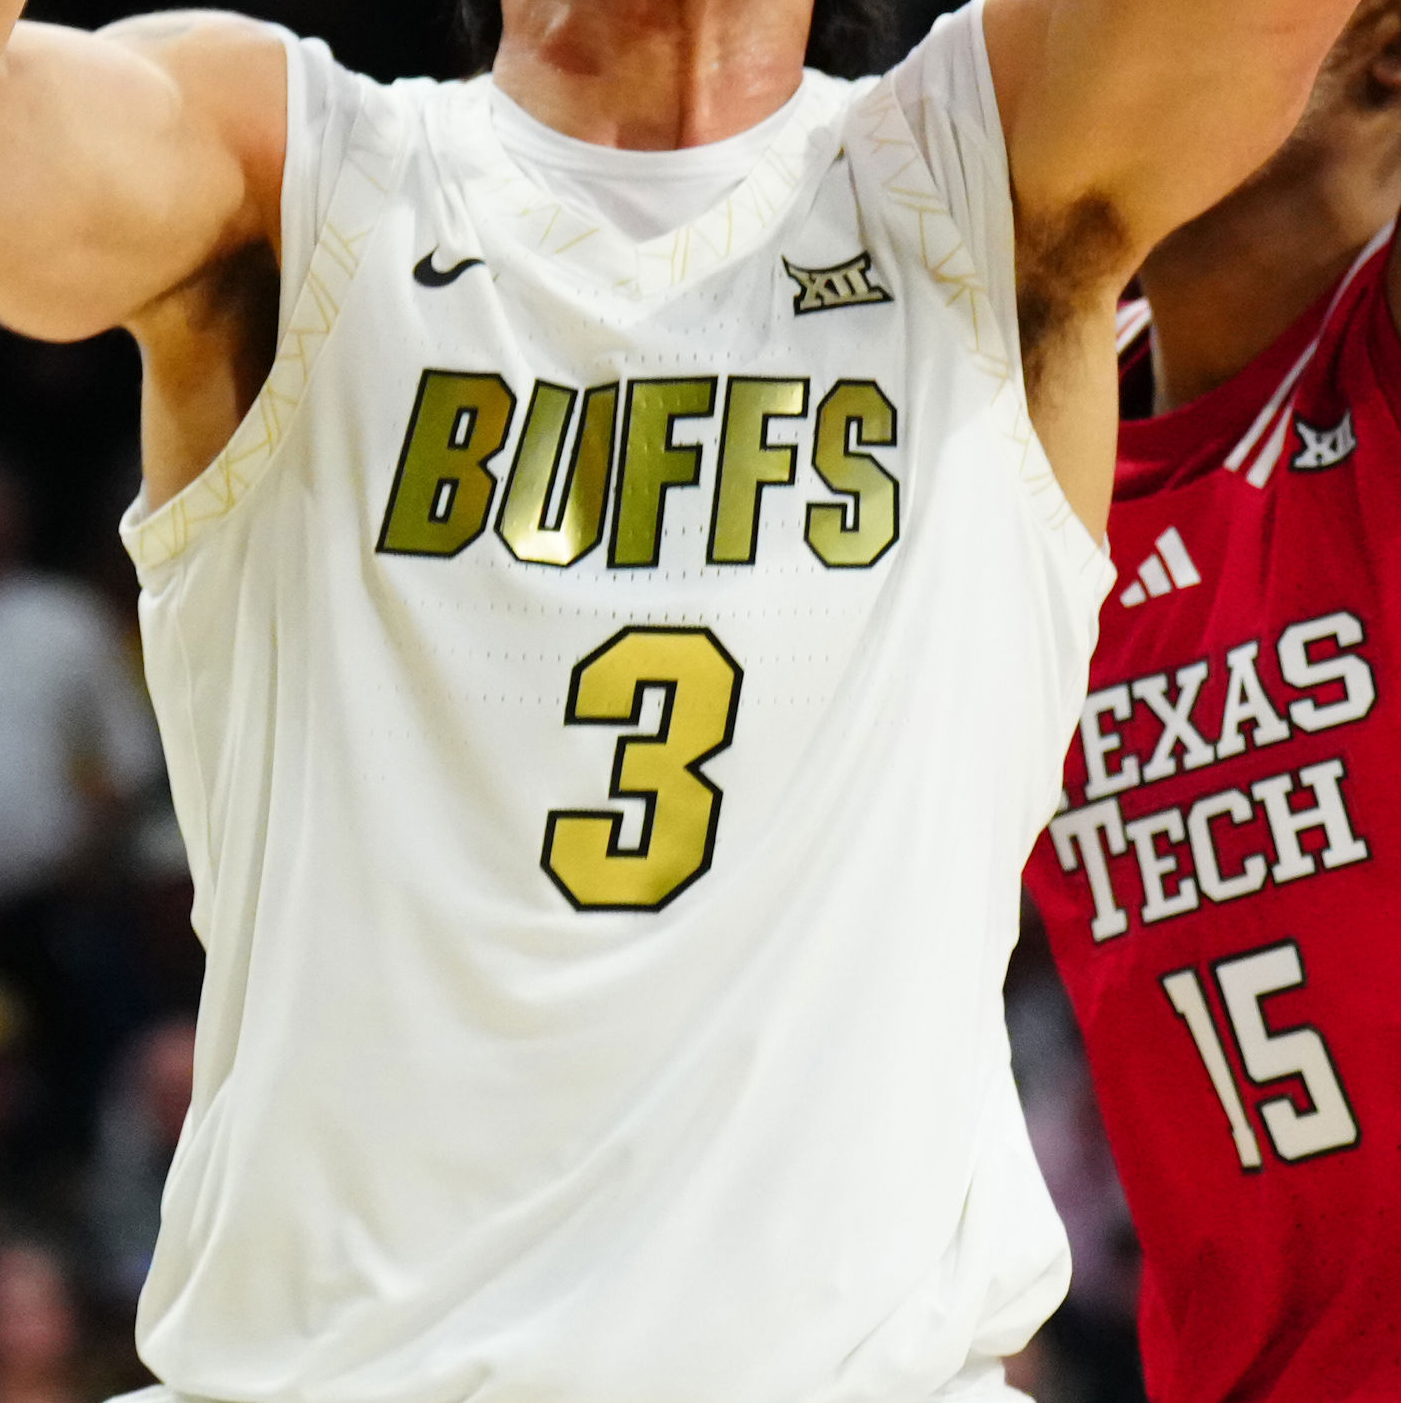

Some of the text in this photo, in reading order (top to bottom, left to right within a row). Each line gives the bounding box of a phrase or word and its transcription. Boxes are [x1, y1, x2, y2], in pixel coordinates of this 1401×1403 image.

[376, 368, 900, 569] BUFFS
[541, 625, 744, 912] 3
[1061, 609, 1378, 811] EXAS
[1048, 755, 1373, 945] TECH
[1161, 939, 1362, 1176] 15
